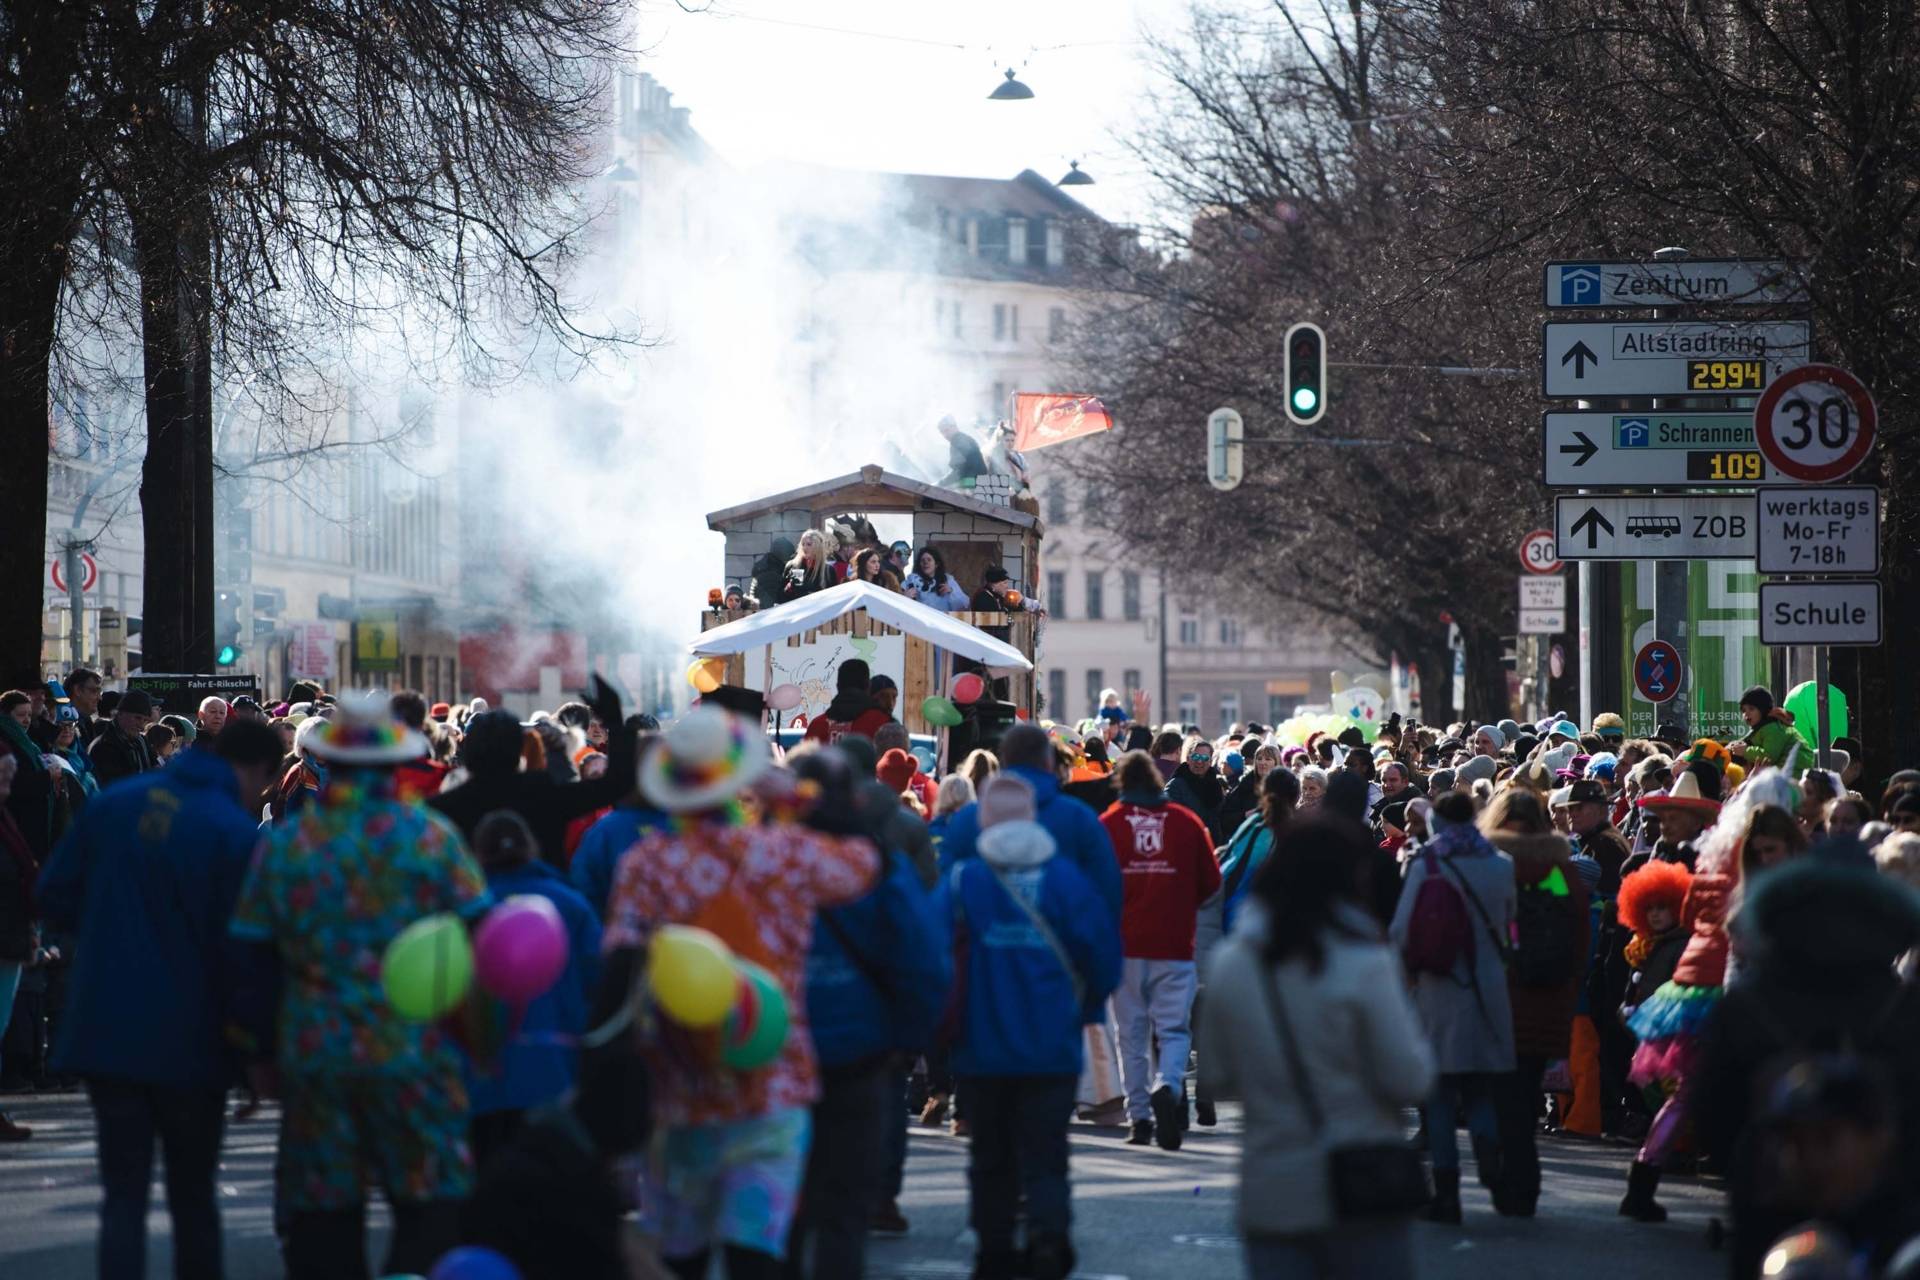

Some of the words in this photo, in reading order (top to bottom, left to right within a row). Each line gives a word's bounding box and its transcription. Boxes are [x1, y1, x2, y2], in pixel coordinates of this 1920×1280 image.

[1613, 273, 1728, 296] Zentrum
[1621, 331, 1766, 357] Altstadtring
[1693, 363, 1761, 389] 2994
[1658, 422, 1755, 442] Schrannen
[1781, 398, 1849, 450] 30
[1710, 453, 1761, 479] 109
[1767, 497, 1869, 520] werktags
[1692, 515, 1746, 538] ZOB
[1783, 521, 1852, 540] Mo-Fr
[1530, 543, 1554, 562] 30
[1790, 545, 1846, 564] 7-18h
[1775, 602, 1866, 625] Schule
[187, 680, 206, 688] Fahr
[1632, 711, 1652, 721] DER
[1701, 711, 1715, 721] ZU
[1718, 711, 1743, 721] SEIN
